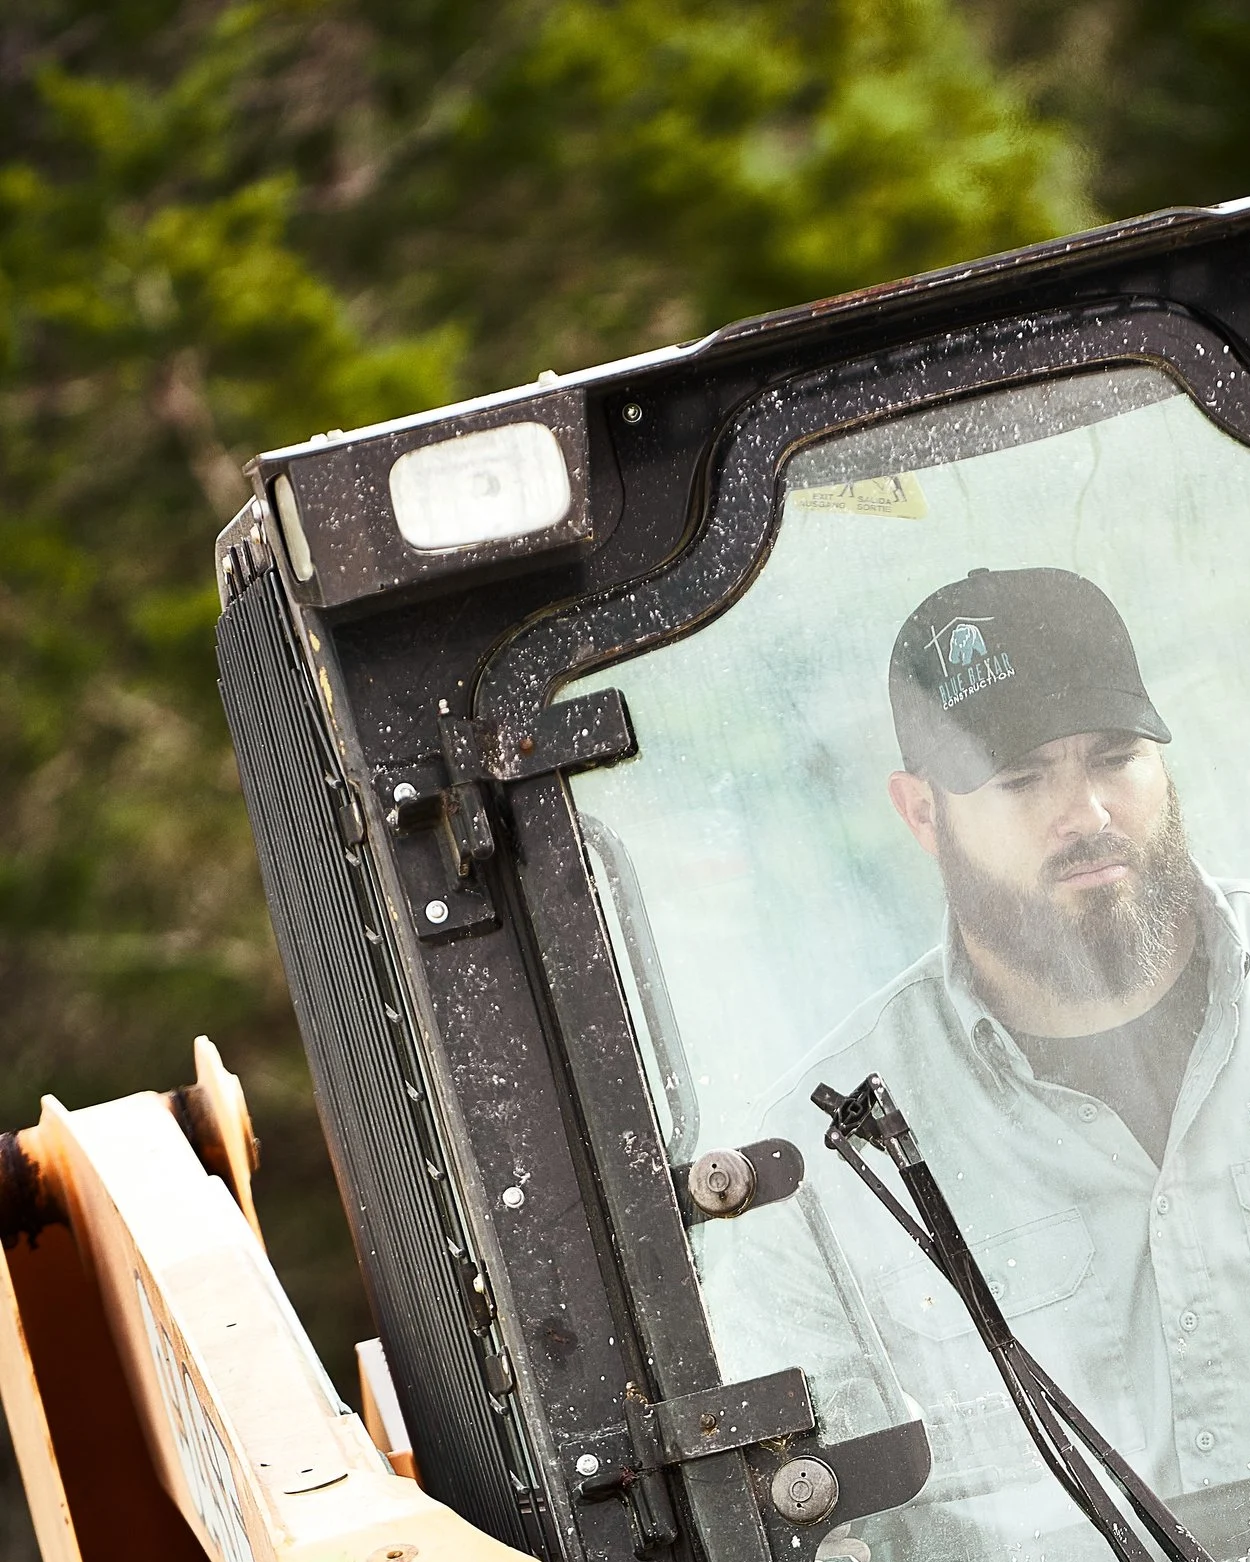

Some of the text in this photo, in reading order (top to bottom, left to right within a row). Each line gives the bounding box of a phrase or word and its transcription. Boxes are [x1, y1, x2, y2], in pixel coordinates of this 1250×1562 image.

[813, 493, 834, 501] EXIT
[857, 495, 892, 505] SALIDA
[857, 503, 892, 513] SORTIE
[939, 652, 1012, 703] BLUE BEXAR
[942, 666, 1016, 711] CONSTRUCTION
